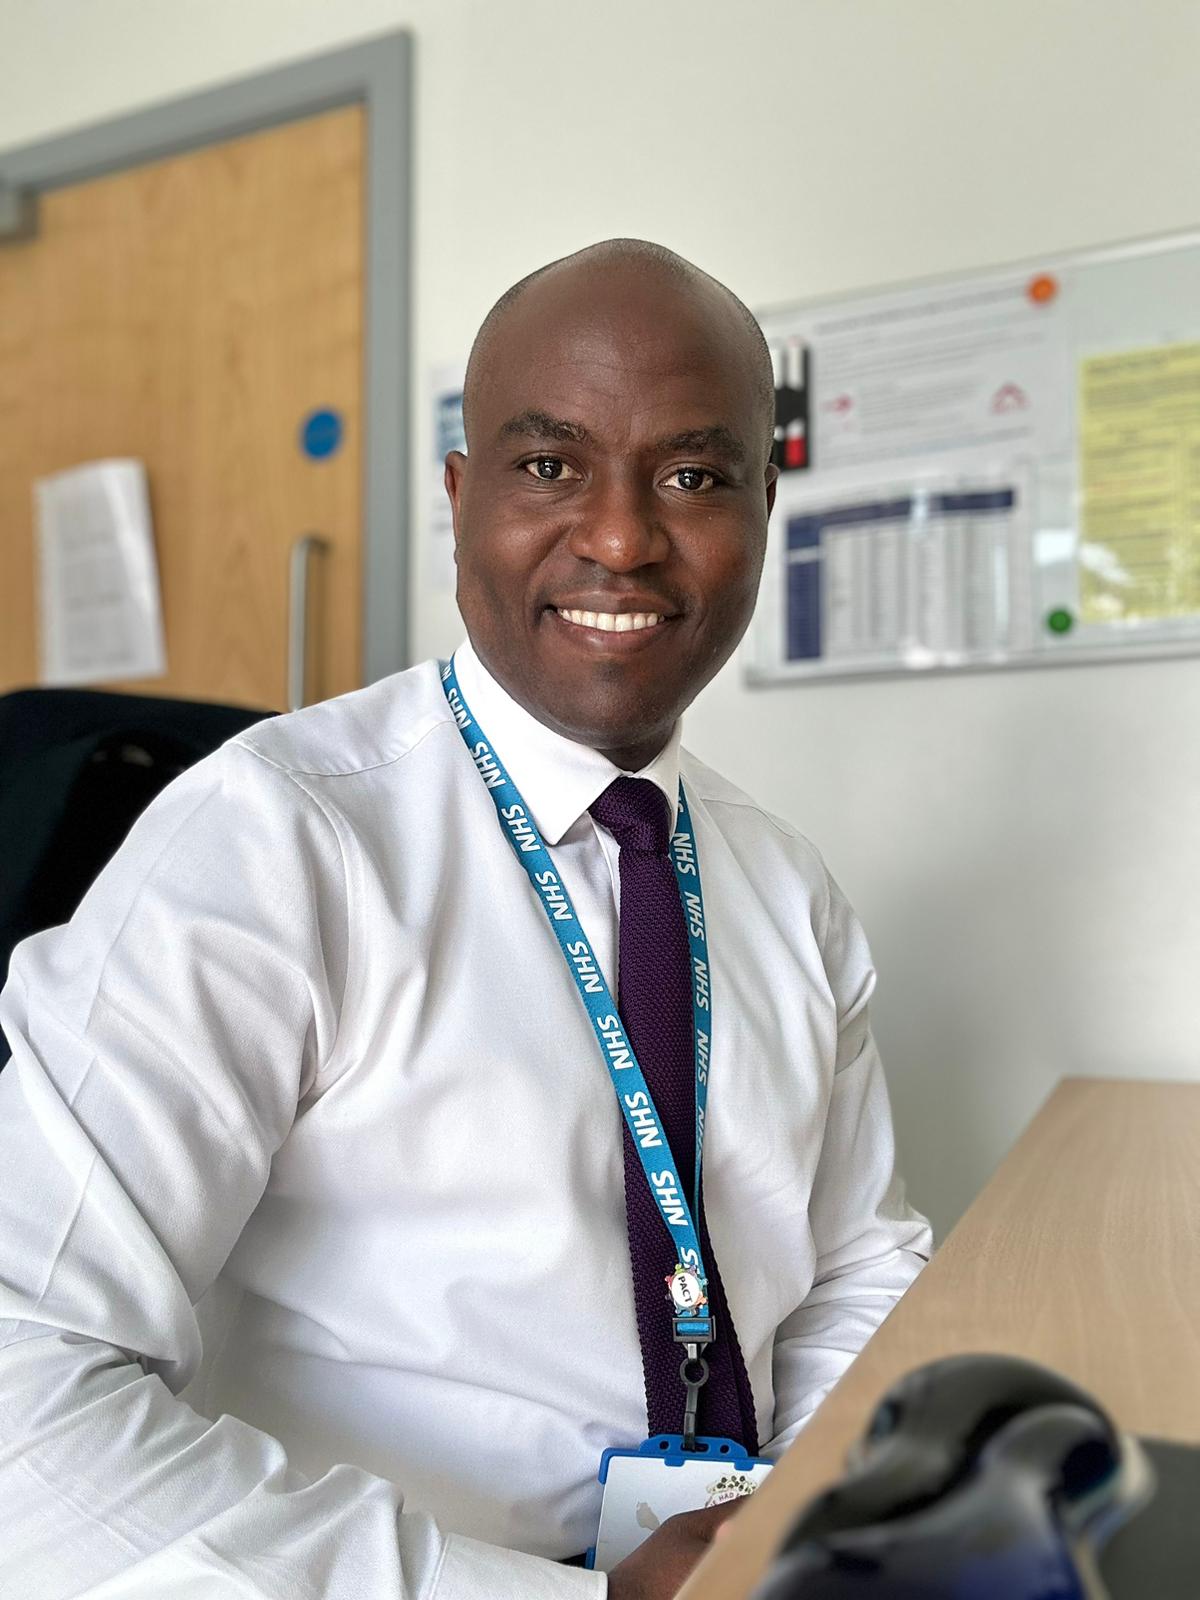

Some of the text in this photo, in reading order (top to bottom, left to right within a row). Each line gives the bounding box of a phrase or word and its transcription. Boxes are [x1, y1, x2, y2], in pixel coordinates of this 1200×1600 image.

[674, 832, 696, 876] NHS
[684, 891, 705, 941] NHS
[448, 688, 688, 1226] NHS NHS NHS NHS NHS NHS NHS NHS
[694, 957, 709, 1012] NHS
[697, 1029, 709, 1087] NHS
[677, 1276, 693, 1303] PACT
